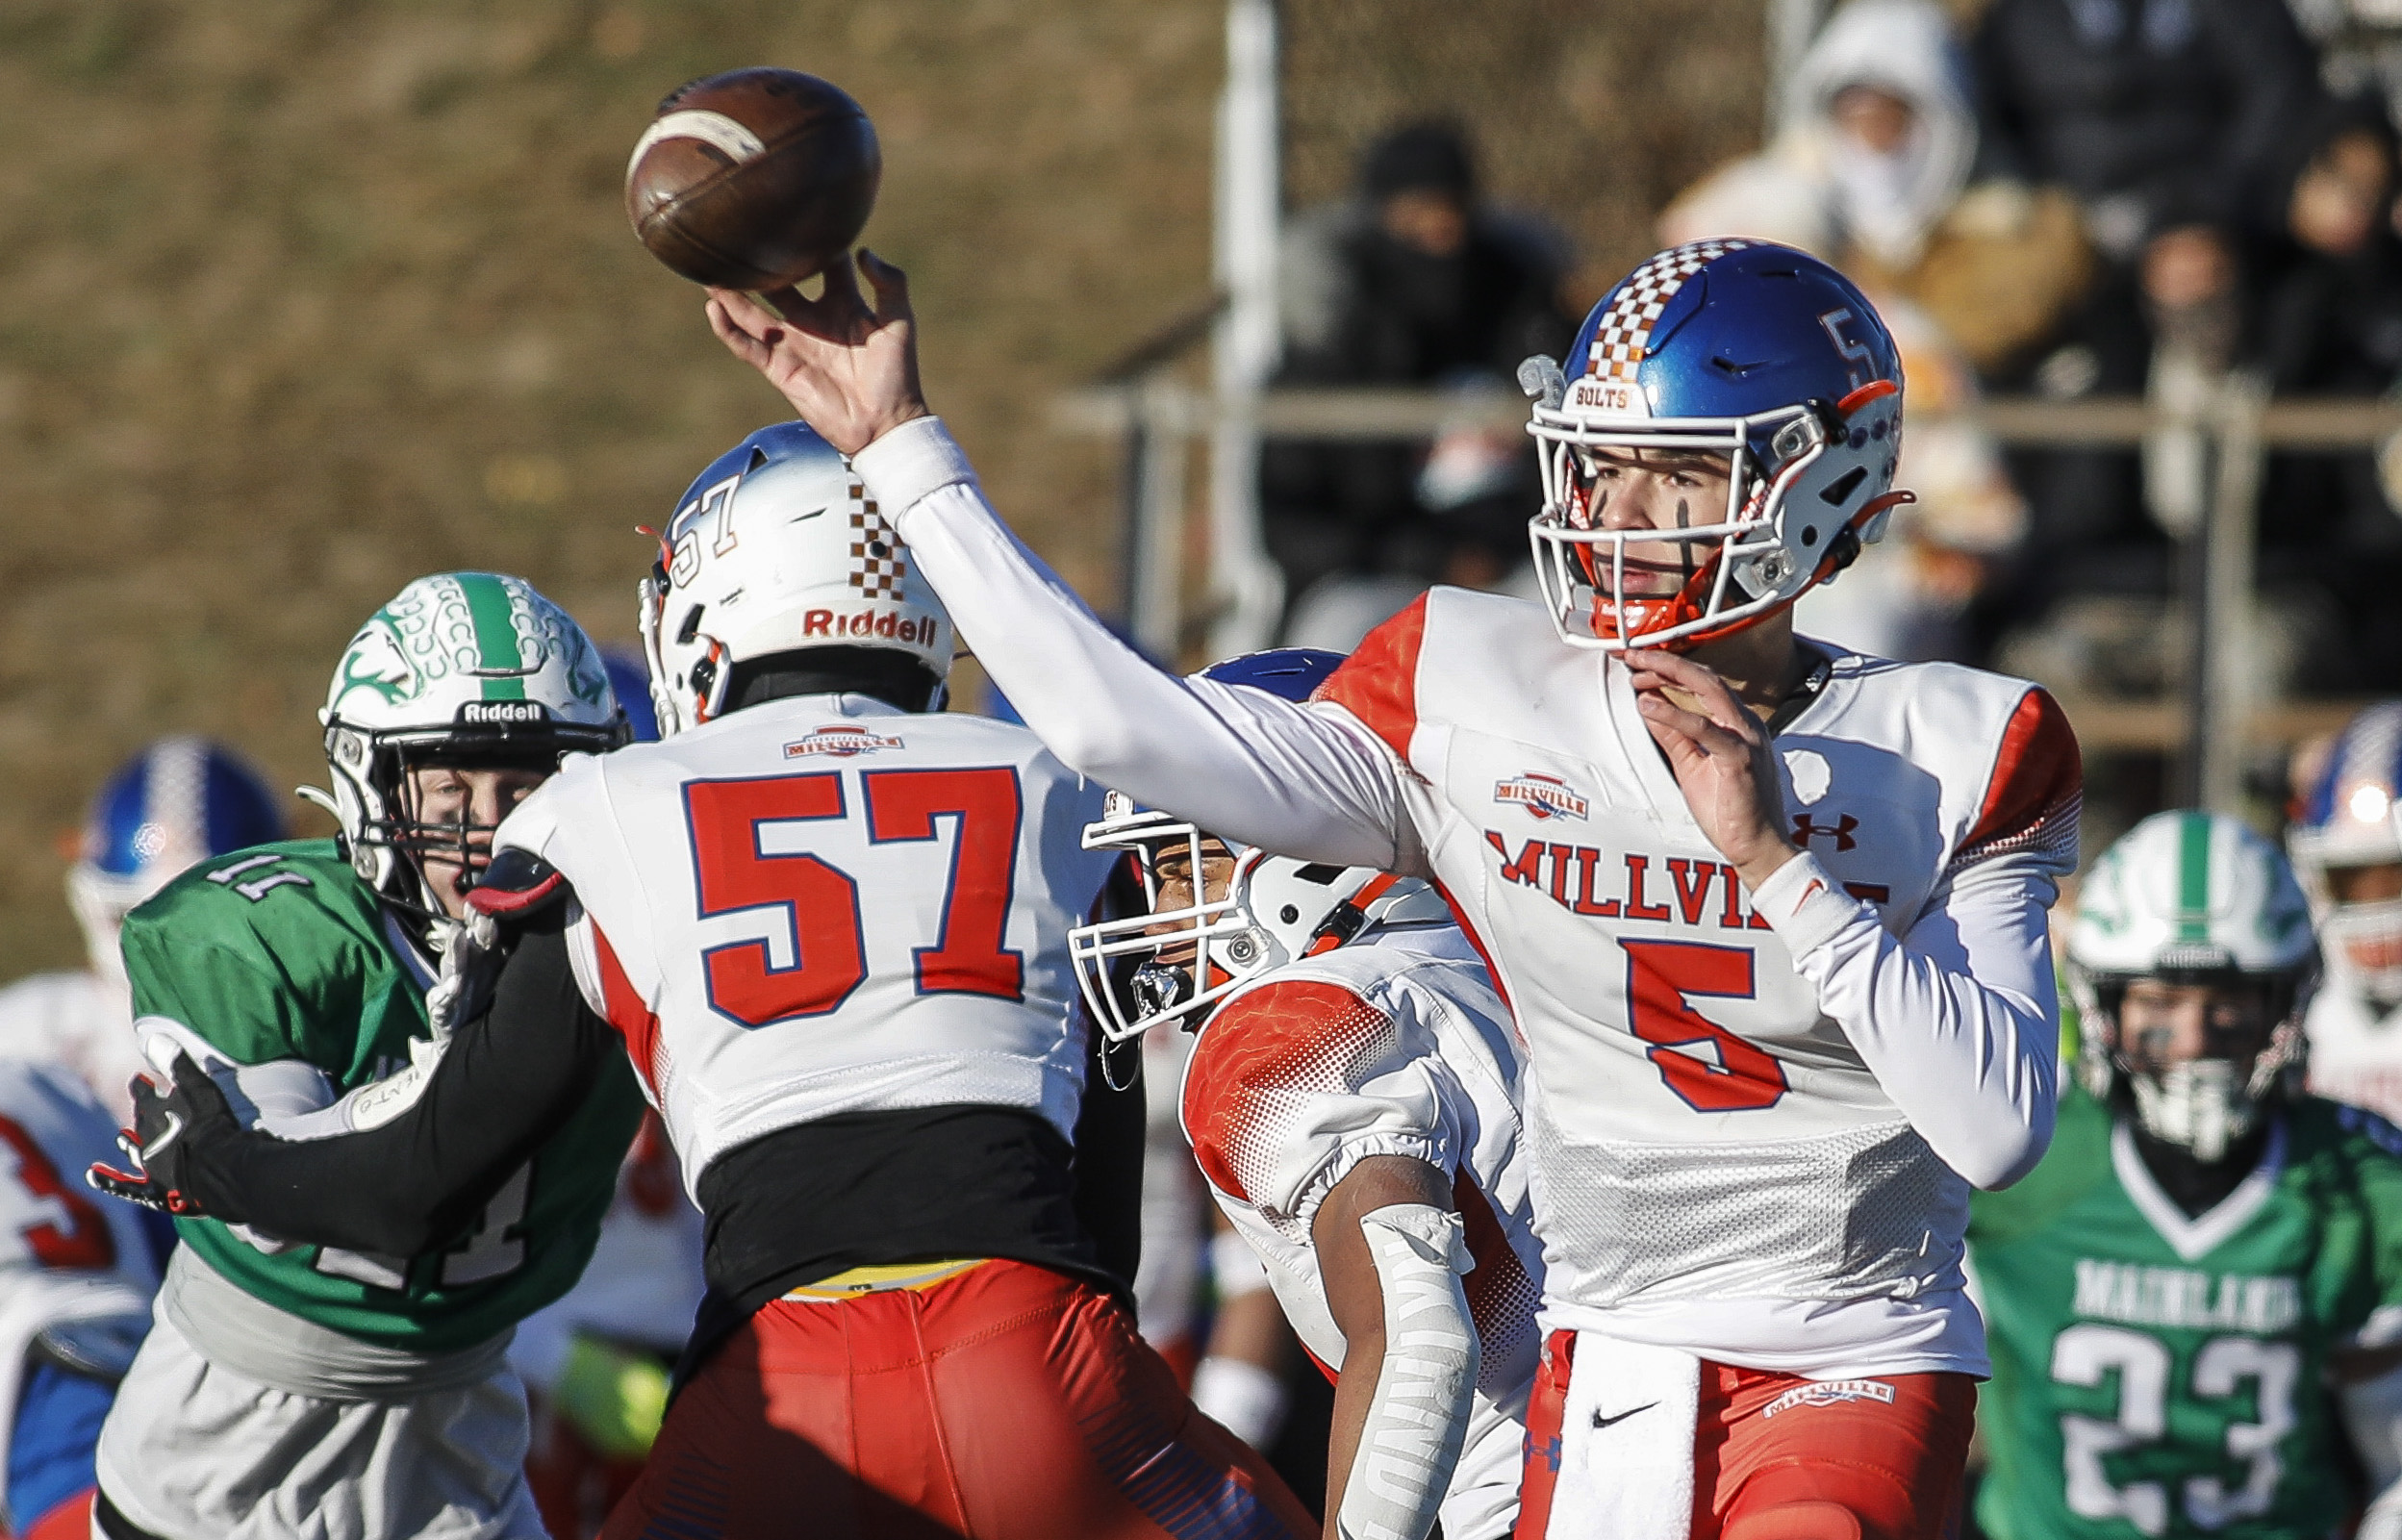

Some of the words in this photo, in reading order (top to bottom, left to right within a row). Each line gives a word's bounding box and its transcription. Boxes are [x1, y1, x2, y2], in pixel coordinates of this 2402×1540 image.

[1577, 386, 1628, 409] BOLTS
[667, 473, 743, 590] 57
[801, 608, 938, 649] Riddell
[464, 703, 542, 722] Riddell
[1498, 784, 1585, 815] MILLVILLE
[684, 766, 1025, 1029] 57
[1483, 828, 1891, 930] MILLVI
[1617, 938, 1792, 1114] 5
[2051, 1322, 2300, 1538] 23
